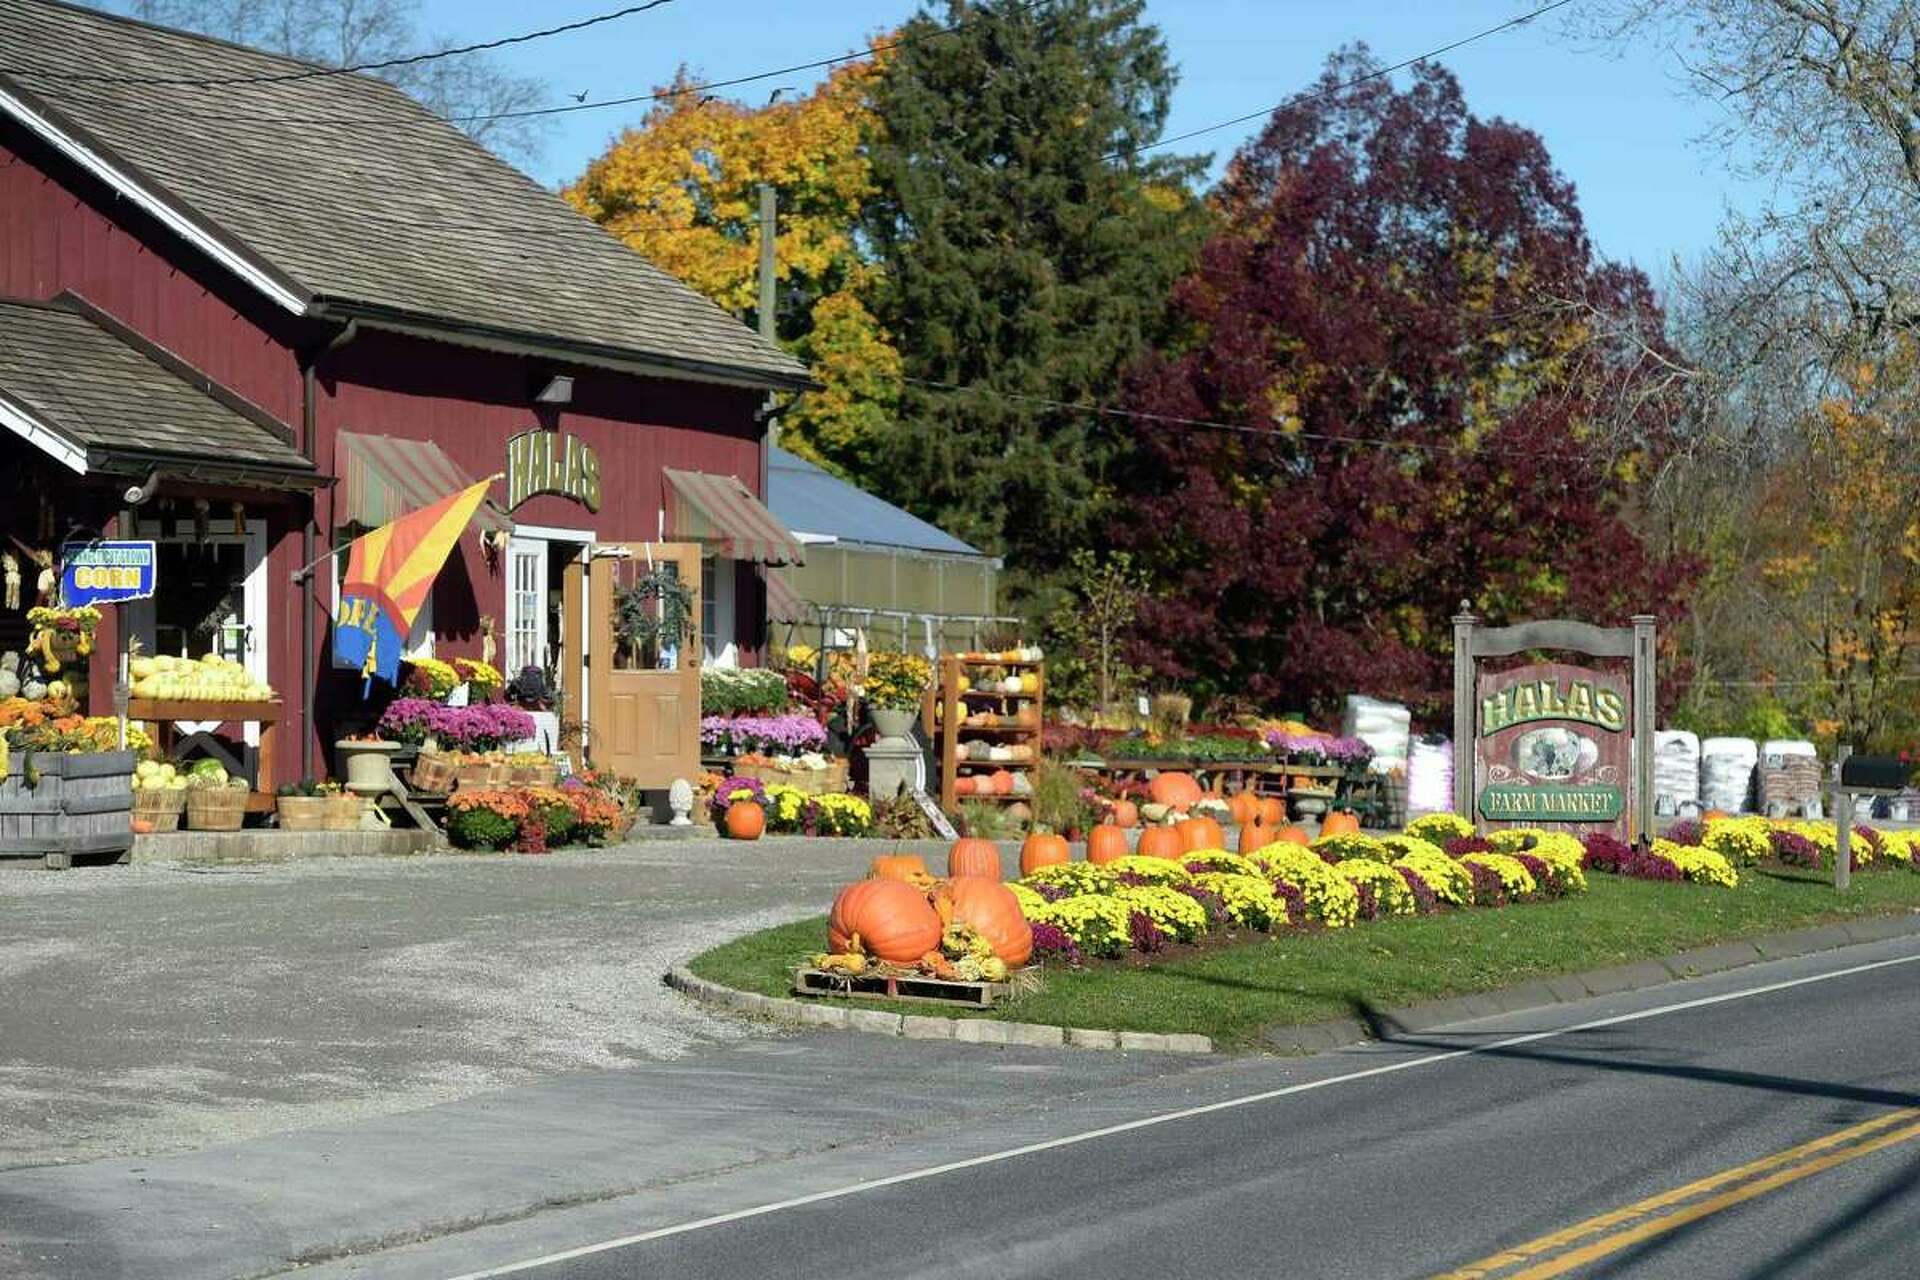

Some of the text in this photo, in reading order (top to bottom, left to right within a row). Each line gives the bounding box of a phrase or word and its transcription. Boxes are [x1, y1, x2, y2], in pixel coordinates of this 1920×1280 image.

[508, 430, 601, 511] HALAS
[75, 566, 141, 589] CORN
[1482, 680, 1626, 737] HALAS
[1490, 793, 1613, 812] FARM MARKET
